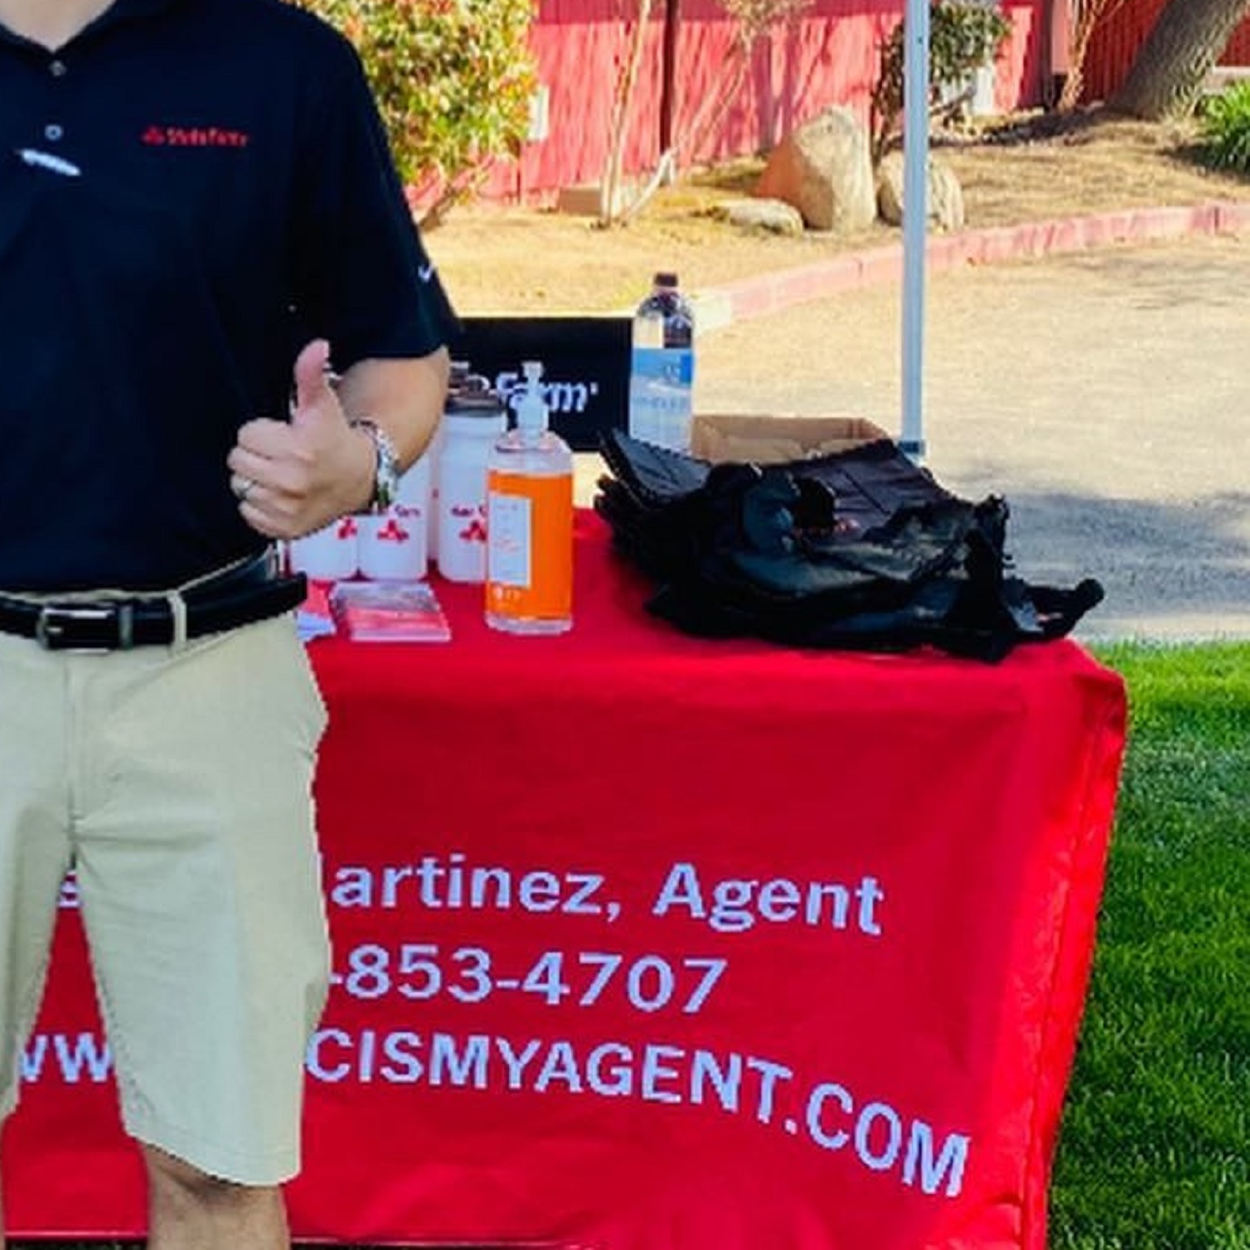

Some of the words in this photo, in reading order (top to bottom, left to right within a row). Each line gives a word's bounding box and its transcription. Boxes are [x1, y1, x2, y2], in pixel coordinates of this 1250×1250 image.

[331, 853, 620, 922] artinez,
[652, 862, 884, 936] Agent
[328, 944, 728, 1014] -853-4707
